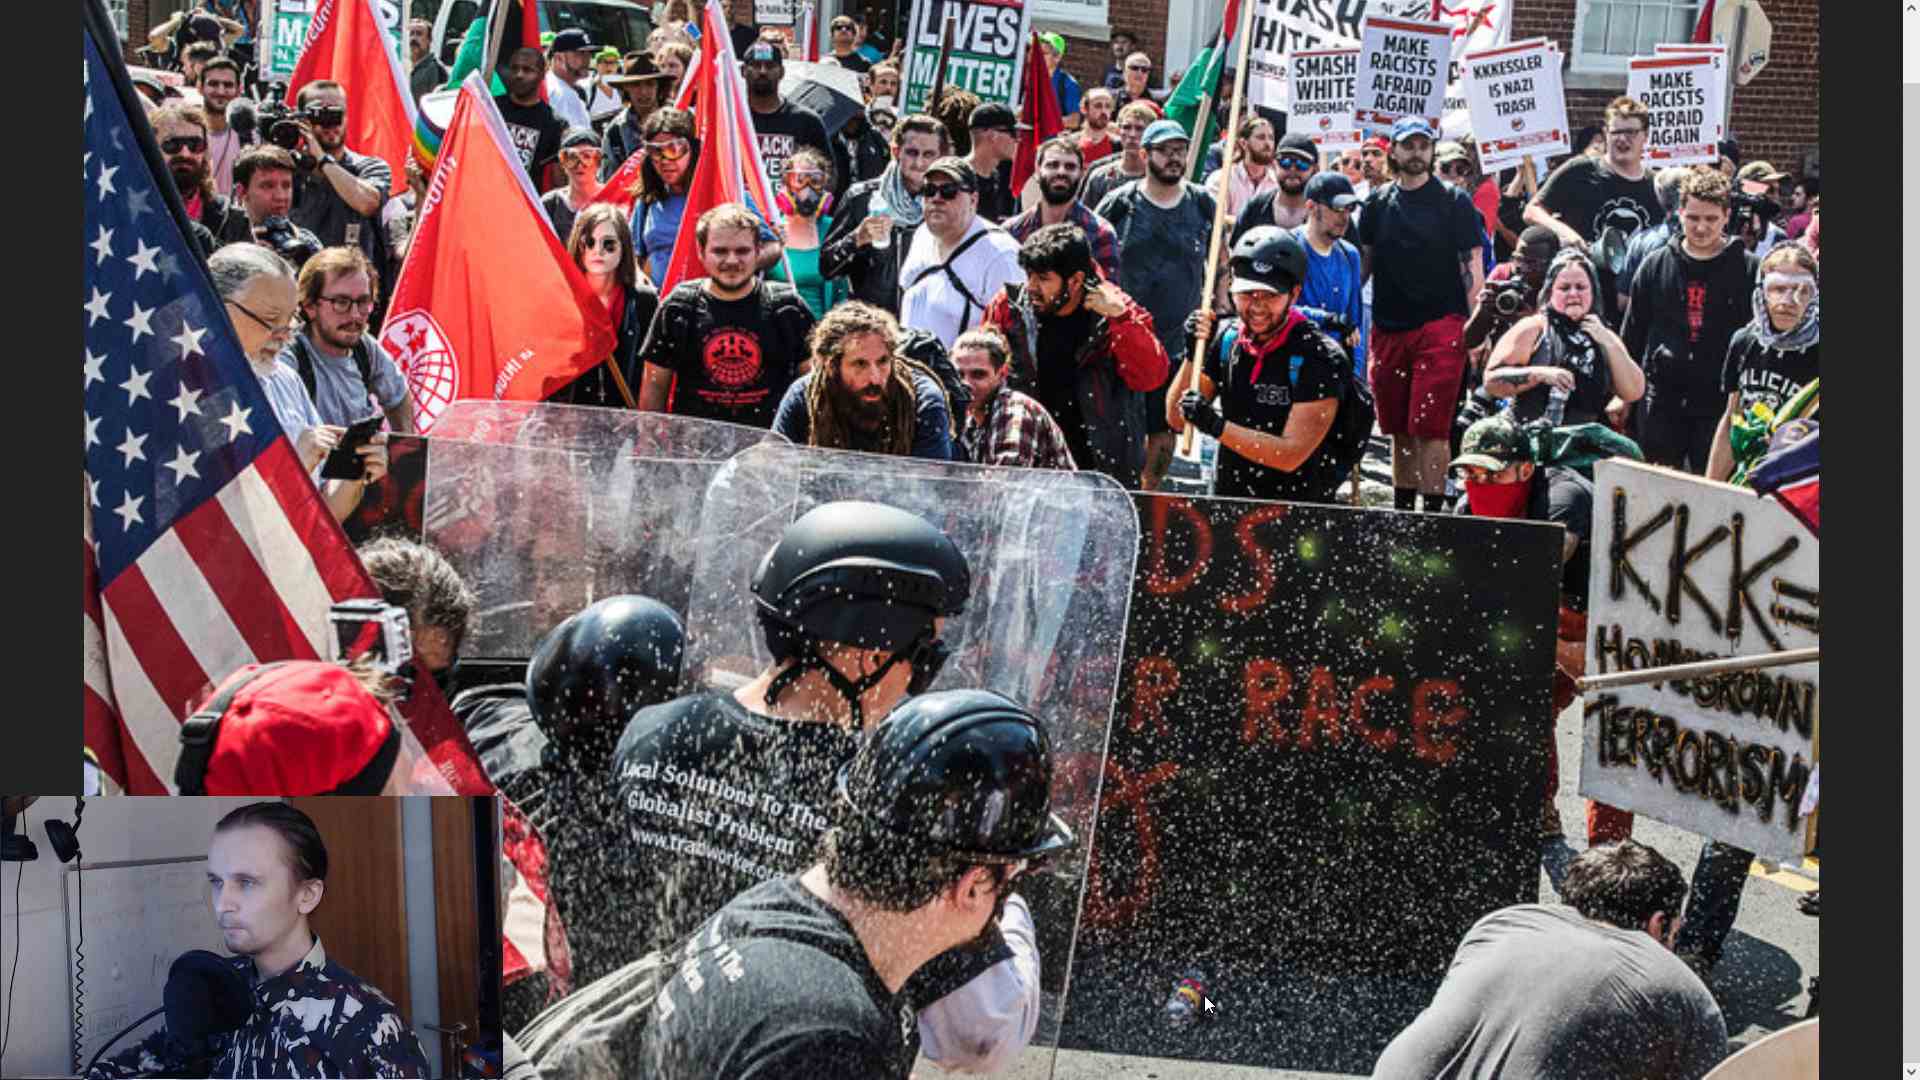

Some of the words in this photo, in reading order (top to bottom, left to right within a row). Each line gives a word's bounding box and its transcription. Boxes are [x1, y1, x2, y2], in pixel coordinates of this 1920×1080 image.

[917, 0, 1018, 57] LIVES
[1383, 34, 1430, 57] MAKE
[1295, 54, 1357, 78] SMASH
[1370, 52, 1437, 77] RACISTS
[1473, 55, 1542, 80] KKKESSLER
[1296, 77, 1357, 101] WHITE
[1372, 74, 1432, 97] AFRAID
[1488, 83, 1501, 98] IS
[1504, 77, 1535, 96] NAZI
[1650, 71, 1694, 90] MAKE
[1293, 101, 1355, 117] SUPREMAC
[1374, 93, 1426, 114] AGAIN
[1494, 97, 1536, 117] TRASH
[1640, 88, 1705, 108] RACISTS
[1648, 109, 1703, 128] AFRAID
[1650, 128, 1700, 146] AGAIN
[1243, 656, 1470, 765] RACE
[1585, 692, 1811, 833] TERRORISM
[662, 764, 758, 808] Solutions
[761, 793, 784, 817] To
[786, 802, 828, 831] The
[627, 789, 715, 828] Globalist
[715, 812, 795, 855] Problem
